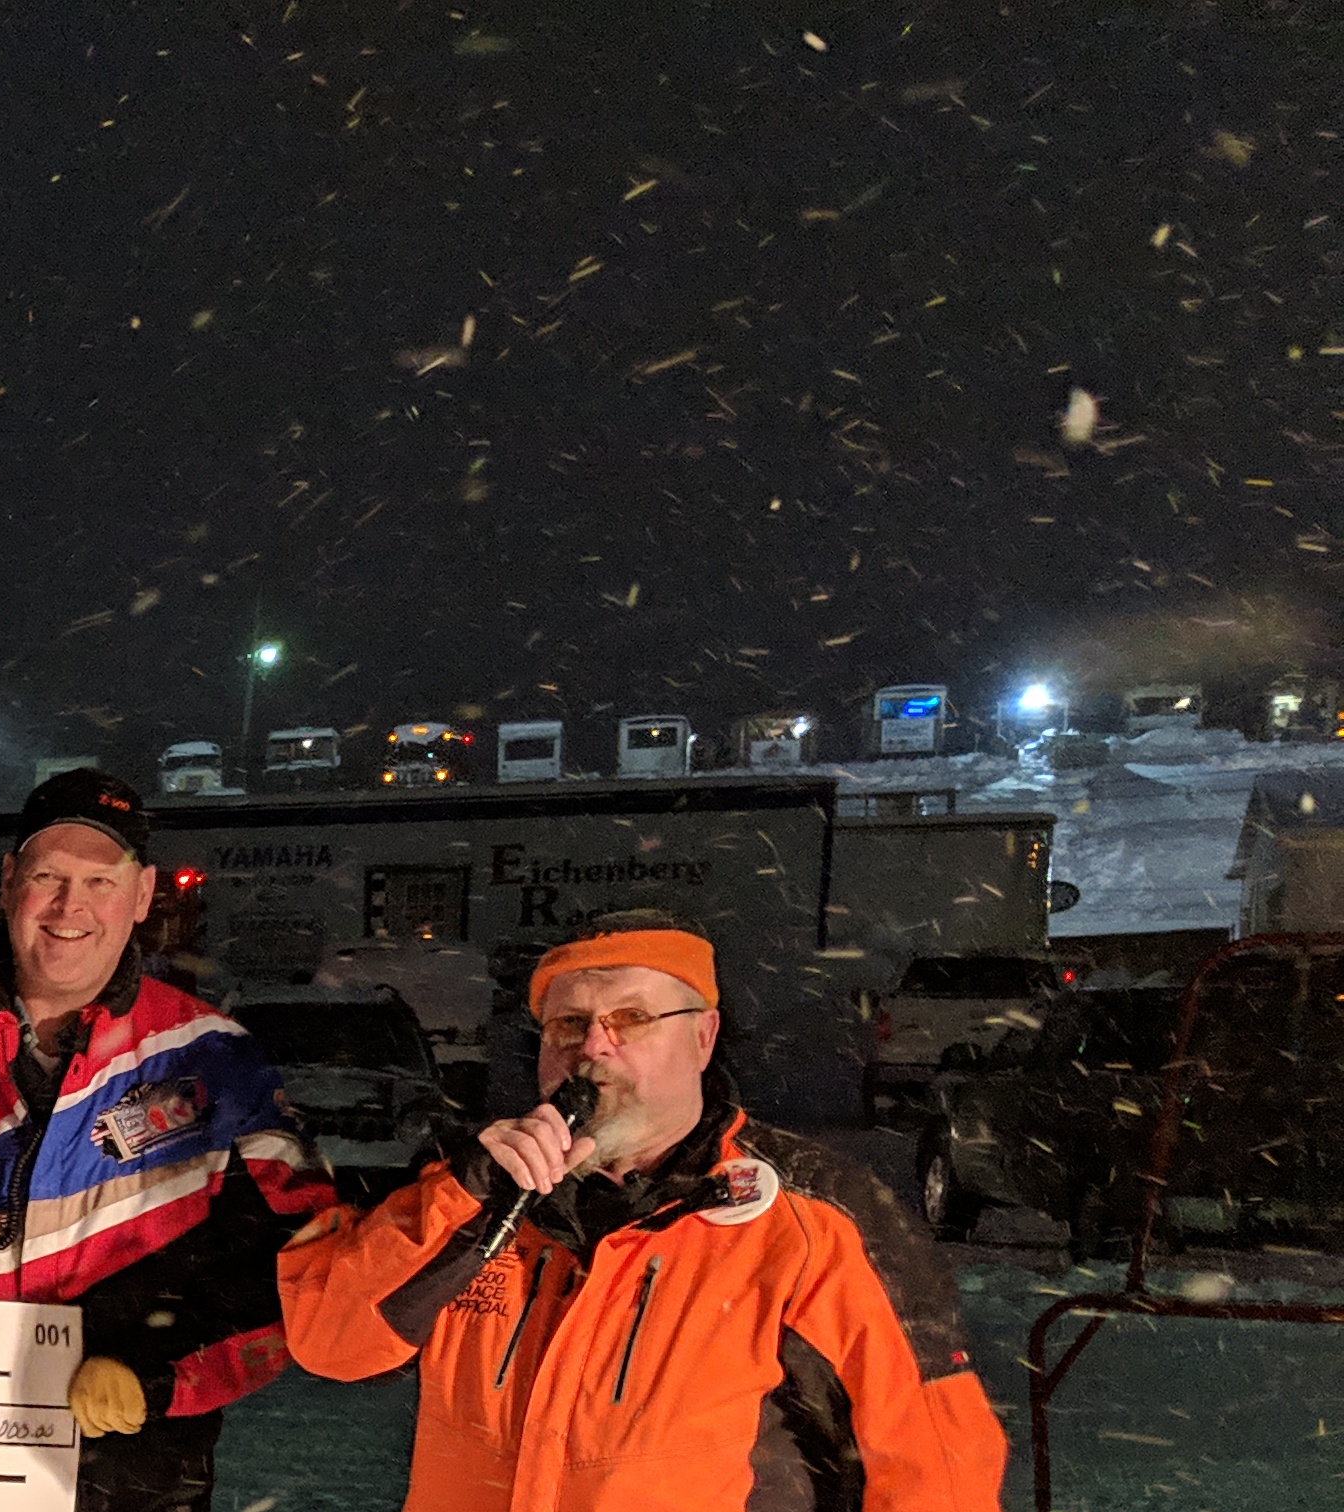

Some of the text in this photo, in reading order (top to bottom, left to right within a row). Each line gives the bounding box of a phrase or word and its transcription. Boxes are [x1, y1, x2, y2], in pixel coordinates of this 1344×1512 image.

[215, 845, 333, 869] YAMAHA
[489, 843, 711, 886] Eichenberg
[34, 1323, 71, 1348] 001
